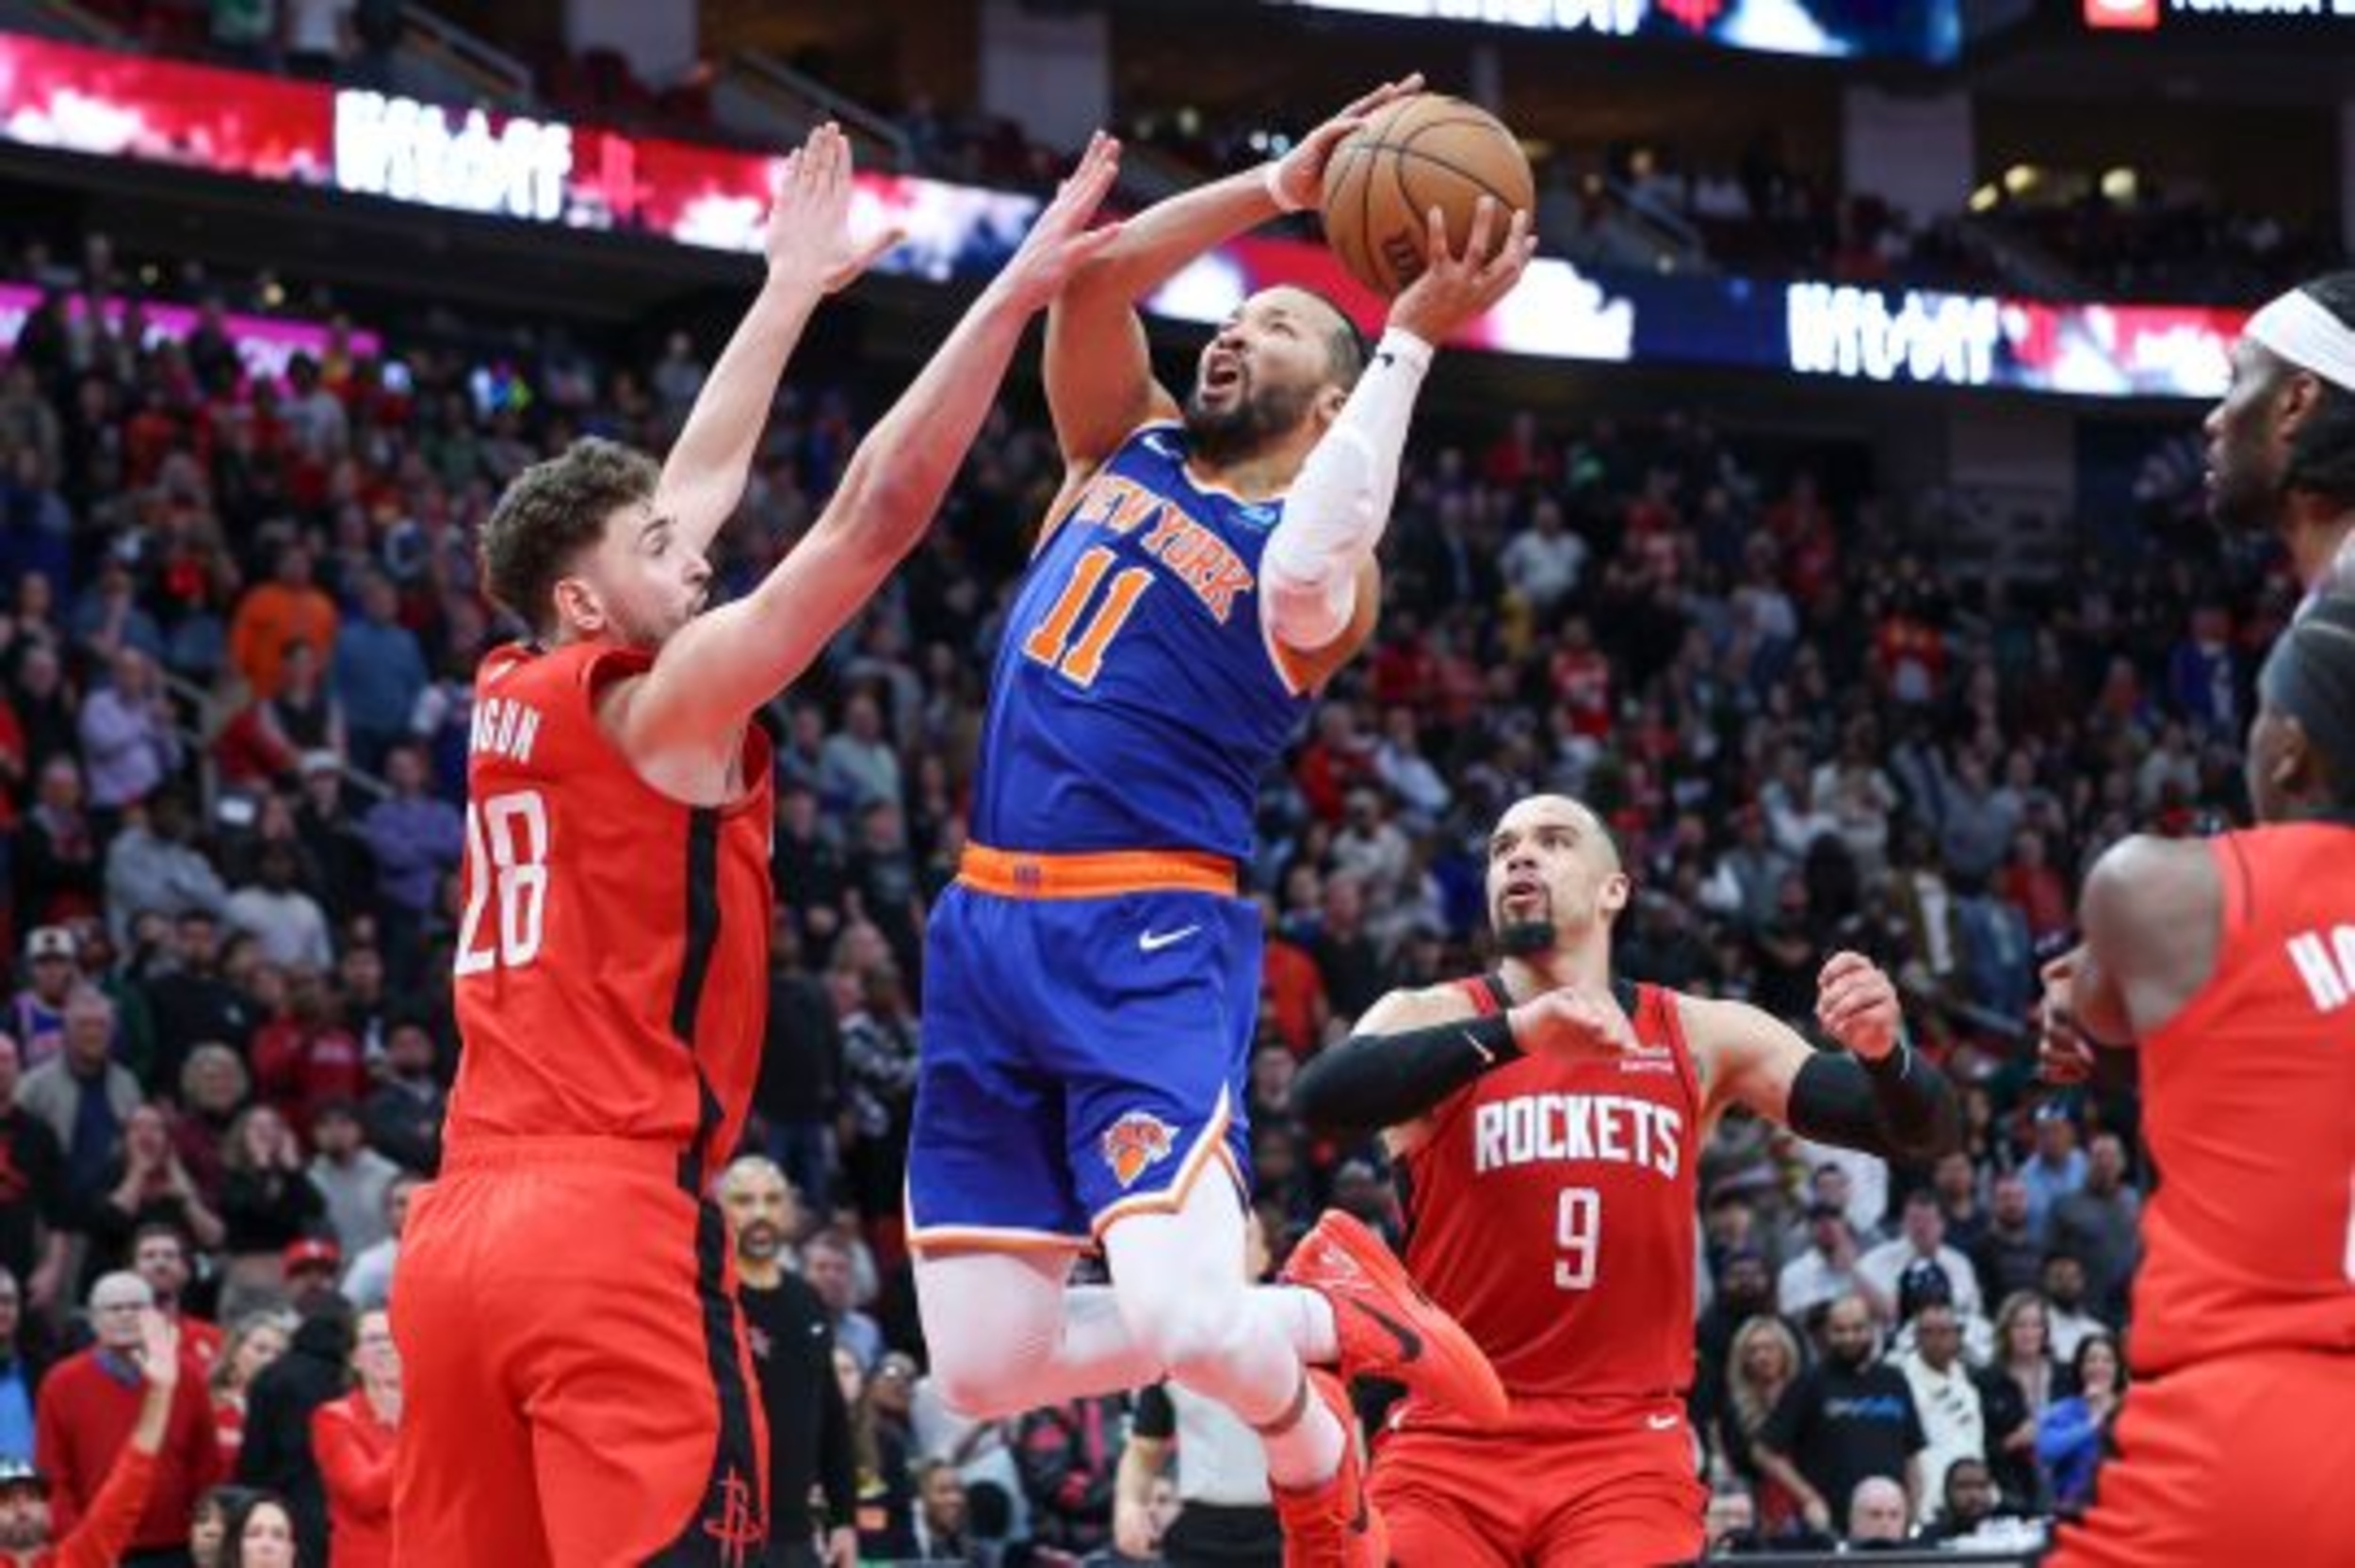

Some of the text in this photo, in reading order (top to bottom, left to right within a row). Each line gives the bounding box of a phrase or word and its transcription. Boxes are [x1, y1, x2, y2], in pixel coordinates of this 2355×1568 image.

[1021, 544, 1156, 688] 11
[1139, 499, 1255, 624] YORK
[454, 790, 548, 975] 28
[1475, 1093, 1682, 1179] ROCKETS
[1555, 1188, 1600, 1289] 9
